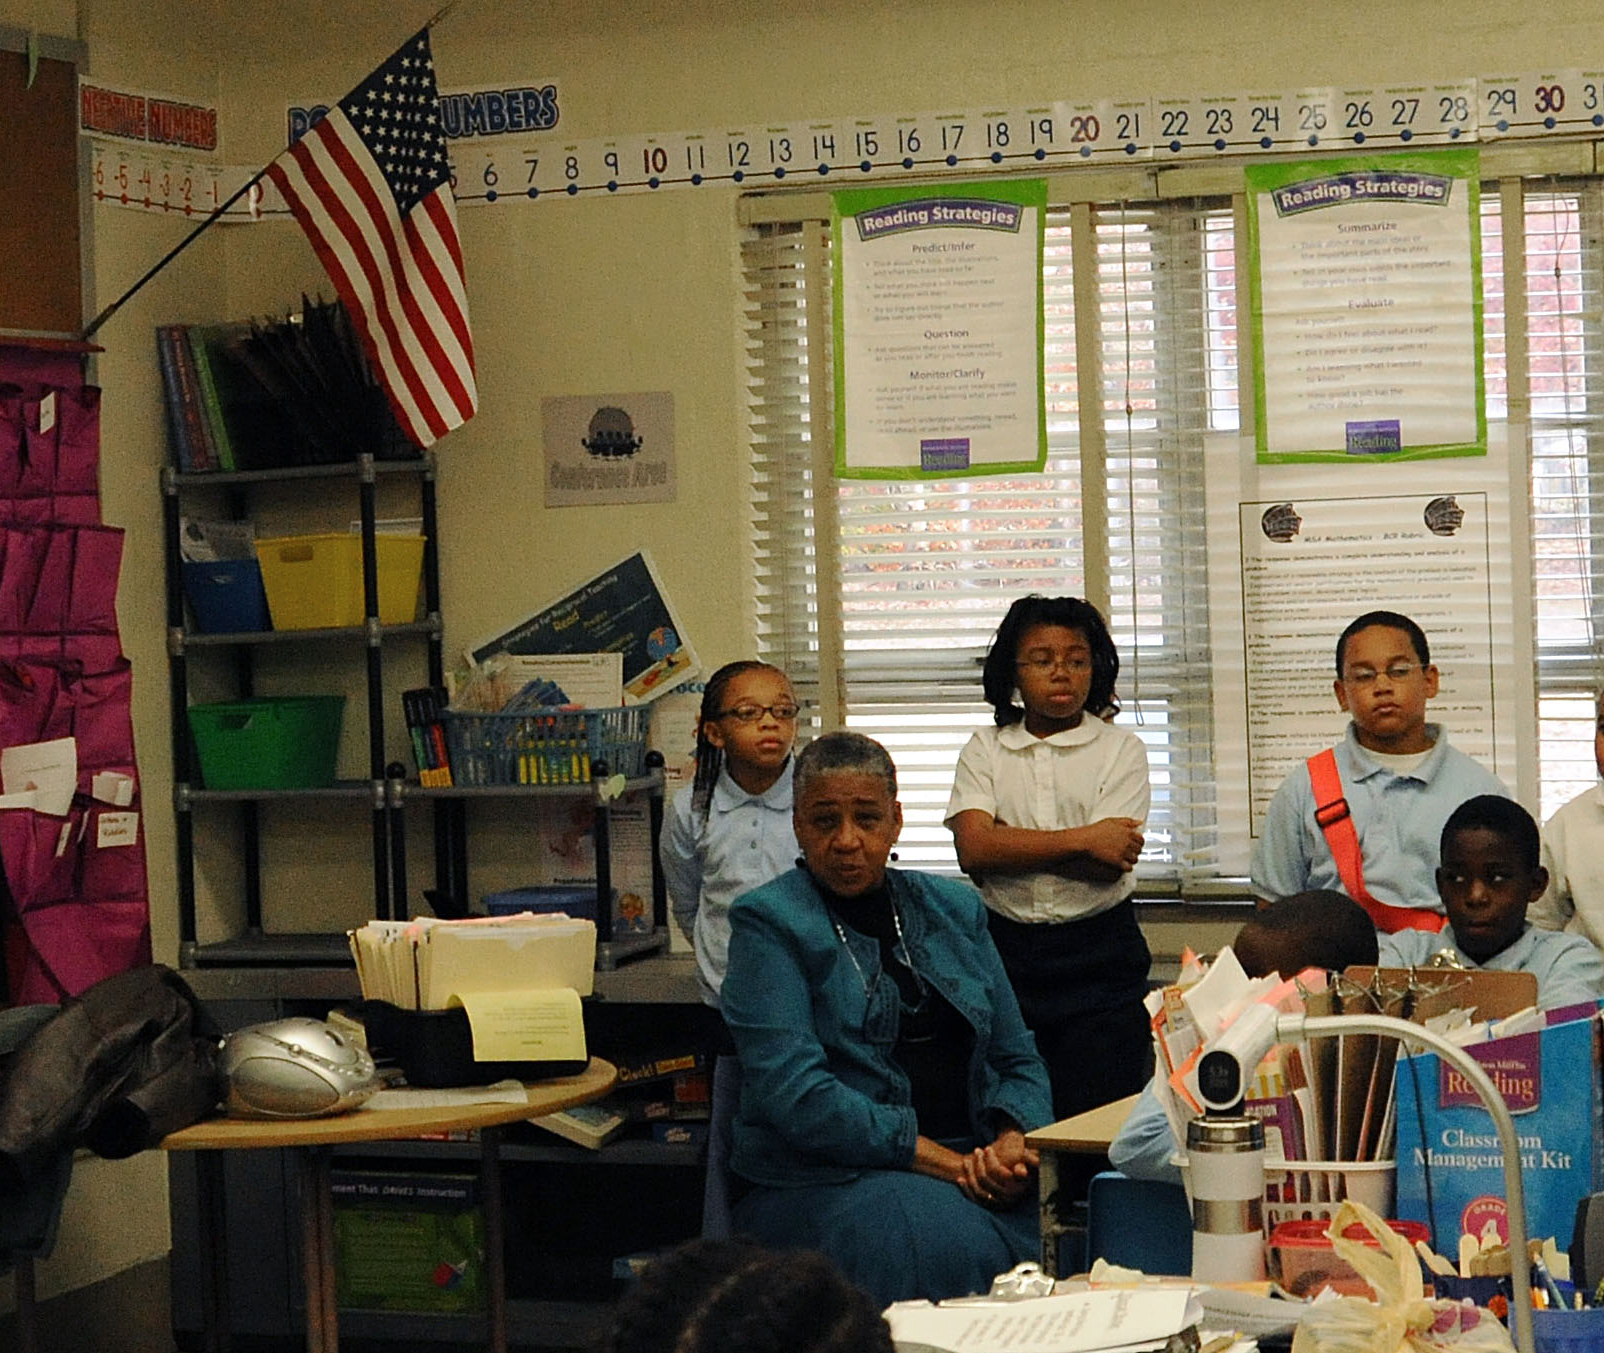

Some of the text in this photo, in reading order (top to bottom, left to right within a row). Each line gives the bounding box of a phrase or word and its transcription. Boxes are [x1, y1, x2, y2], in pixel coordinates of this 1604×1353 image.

[439, 86, 558, 138] UMBERS
[148, 98, 217, 151] NUMBERS
[483, 162, 499, 187] 6
[524, 158, 539, 184] 7
[564, 155, 580, 181] 8
[603, 151, 619, 177] 9
[643, 147, 668, 175] 10
[686, 145, 705, 171] 11
[728, 141, 751, 167] 12
[769, 137, 793, 164] 13
[813, 134, 836, 161] 14
[855, 130, 879, 157] 15
[898, 127, 921, 154] 16
[941, 124, 965, 151] 17
[986, 121, 1010, 148] 18
[1030, 118, 1054, 145] 19
[1070, 115, 1101, 143] 20
[1116, 112, 1140, 140] 21
[1161, 110, 1189, 137] 22
[1205, 108, 1234, 135] 23
[1250, 106, 1280, 133] 24
[1297, 104, 1328, 131] 25
[1344, 101, 1374, 129] 26
[1391, 98, 1420, 126] 27
[1438, 96, 1469, 124] 28
[1486, 88, 1517, 115] 29
[1534, 84, 1566, 114] 30
[1281, 180, 1444, 207] Reading Strategies
[864, 206, 1016, 231] Reading Strategies
[1337, 222, 1397, 234] Summarize
[912, 241, 975, 253] Predict/Infer
[1348, 298, 1394, 309] Evaluate
[924, 329, 969, 341] Question
[910, 368, 985, 381] Monitor/Clarify
[1448, 1072, 1534, 1101] Reing
[1442, 1129, 1542, 1149] Classrom
[1414, 1148, 1572, 1171] Managemnt Kit
